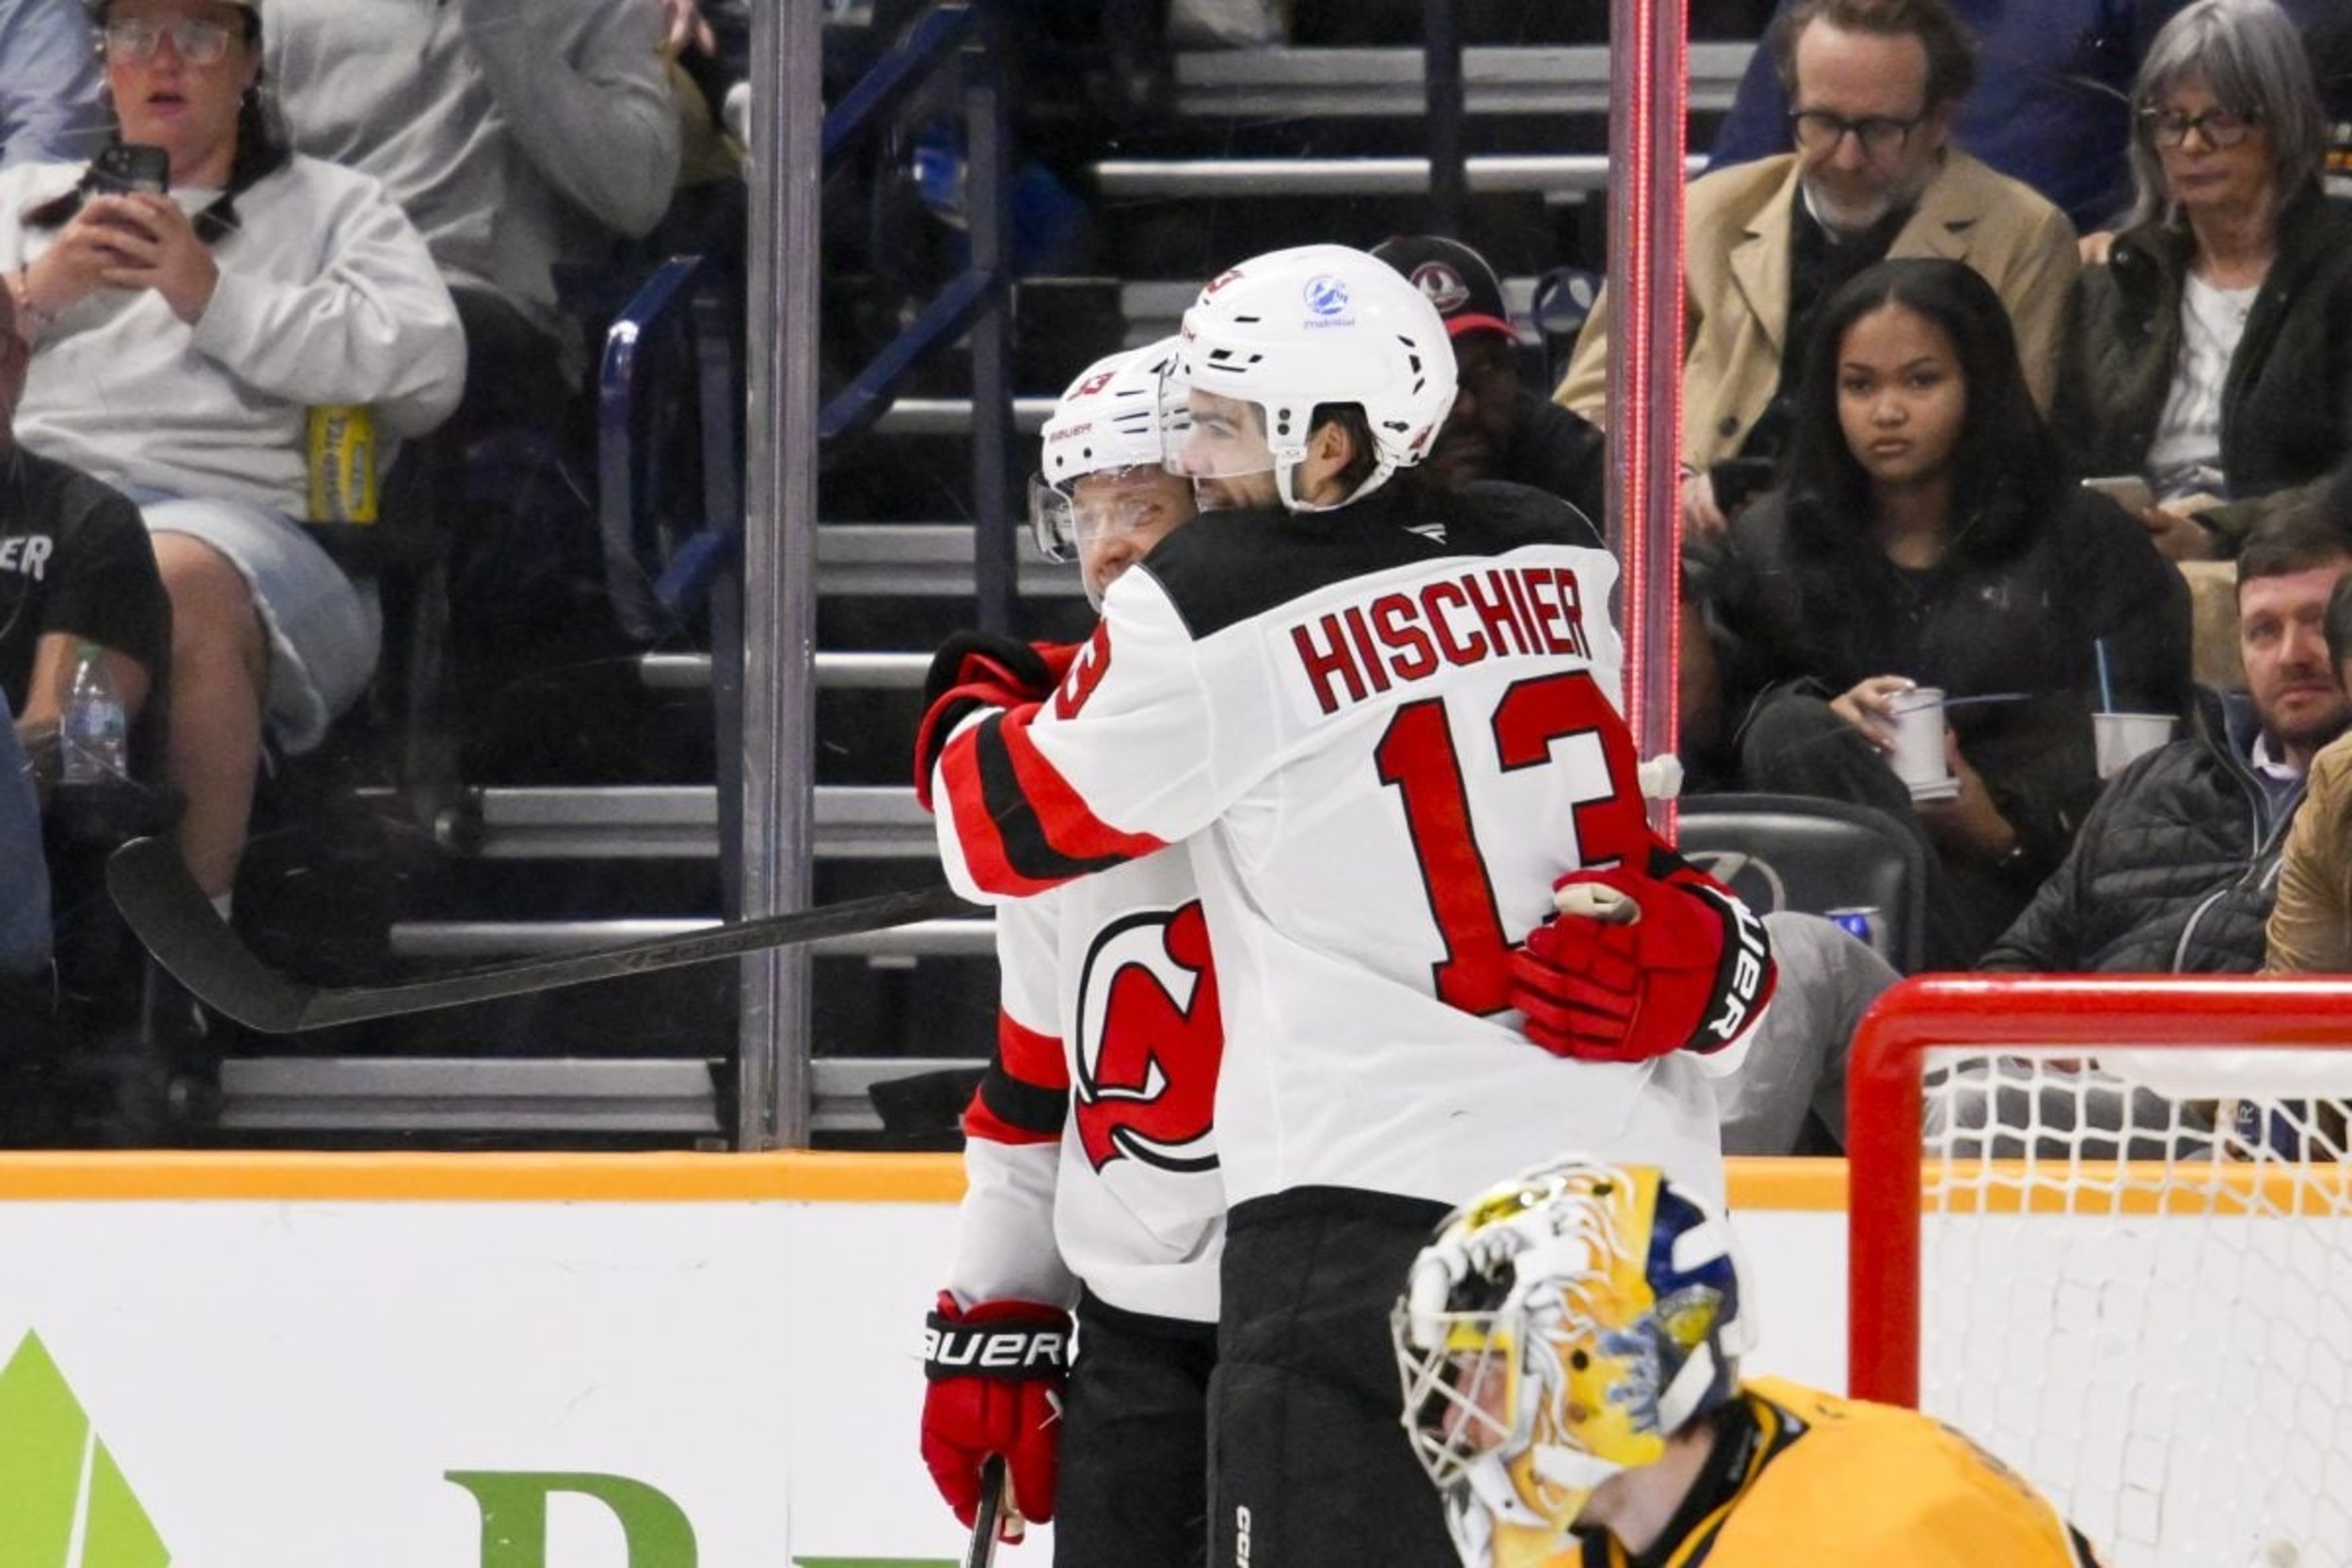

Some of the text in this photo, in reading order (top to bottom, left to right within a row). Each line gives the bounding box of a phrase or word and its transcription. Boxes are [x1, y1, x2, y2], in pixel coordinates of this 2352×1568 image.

[0, 534, 54, 581] ER
[1290, 567, 1593, 715] HISCHIER
[1374, 668, 1647, 1018] 13
